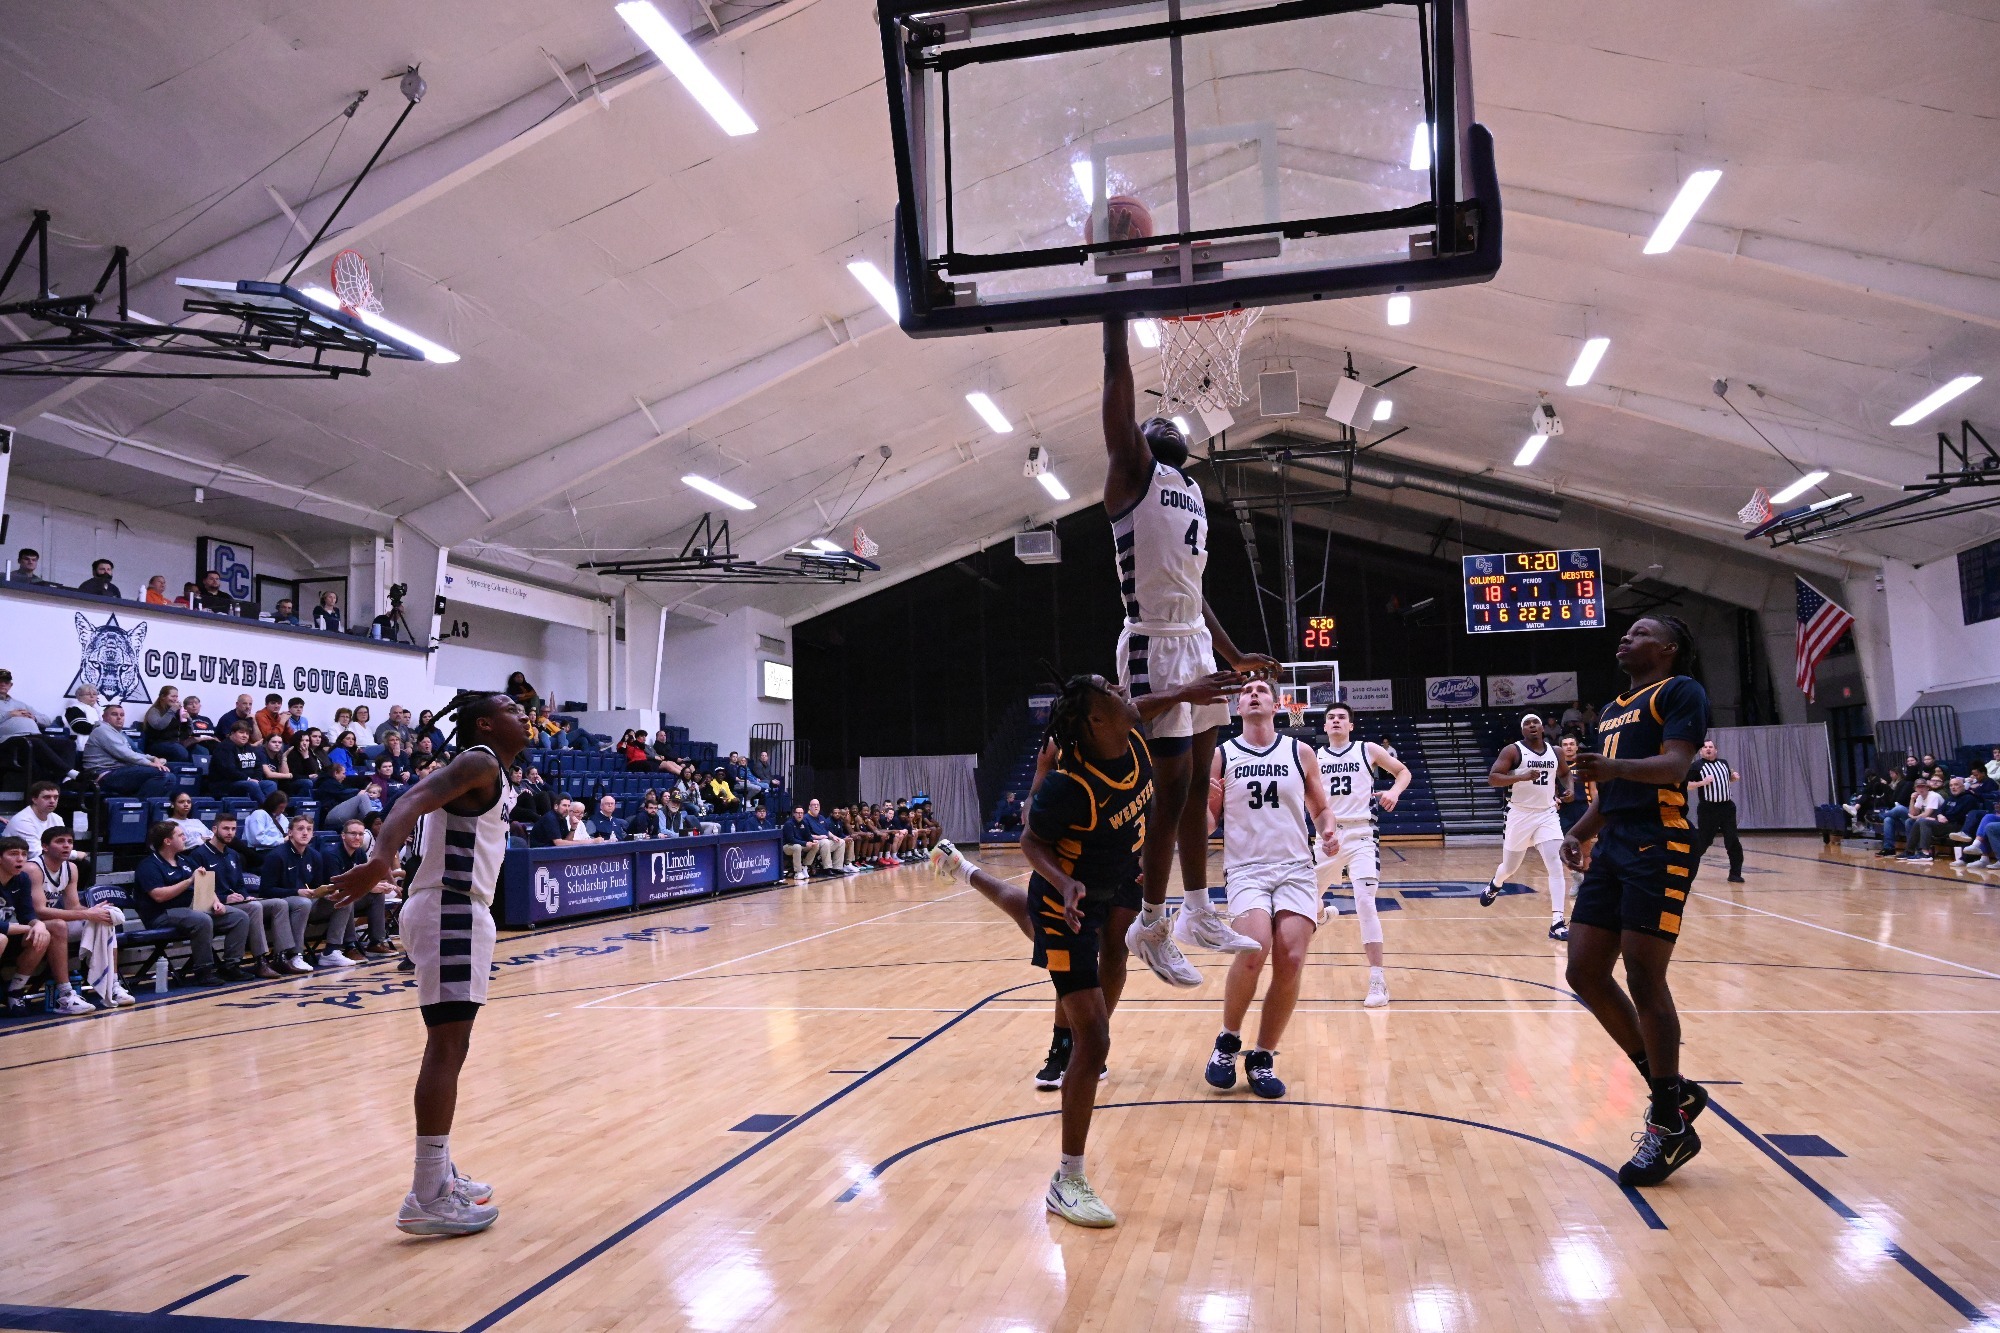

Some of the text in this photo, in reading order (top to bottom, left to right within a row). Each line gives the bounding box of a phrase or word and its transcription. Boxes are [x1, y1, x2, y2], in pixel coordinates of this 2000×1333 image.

[1184, 518, 1198, 555] 4
[1518, 553, 1557, 570] 9:20
[1470, 576, 1505, 584] COLUMBIA
[1561, 570, 1594, 580] WEBSTER
[1486, 586, 1501, 602] 18
[1534, 586, 1538, 598] 1
[1577, 580, 1594, 598] 13
[1484, 610, 1488, 622] 1
[1500, 608, 1508, 622] 6
[1519, 606, 1550, 621] 22 2
[1562, 606, 1570, 619] 6
[1586, 604, 1594, 618] 6
[450, 620, 469, 638] A3
[1310, 618, 1334, 629] 9:20
[1306, 630, 1330, 648] 26
[144, 649, 388, 699] COLUMBIA COUGARS
[1428, 677, 1474, 700] Culver's
[1600, 709, 1640, 733] WEBSTER
[1603, 732, 1620, 760] 11
[1234, 764, 1289, 778] COUGARS
[1320, 762, 1360, 774] COUGARS
[1527, 760, 1554, 769] COUGARS
[1330, 776, 1352, 796] 23
[1246, 781, 1280, 810] 34
[666, 849, 696, 868] Lincoln
[564, 858, 630, 878] COUGAR CLUB &
[568, 874, 628, 894] Scholarship Fund
[92, 890, 127, 902] COUGARS
